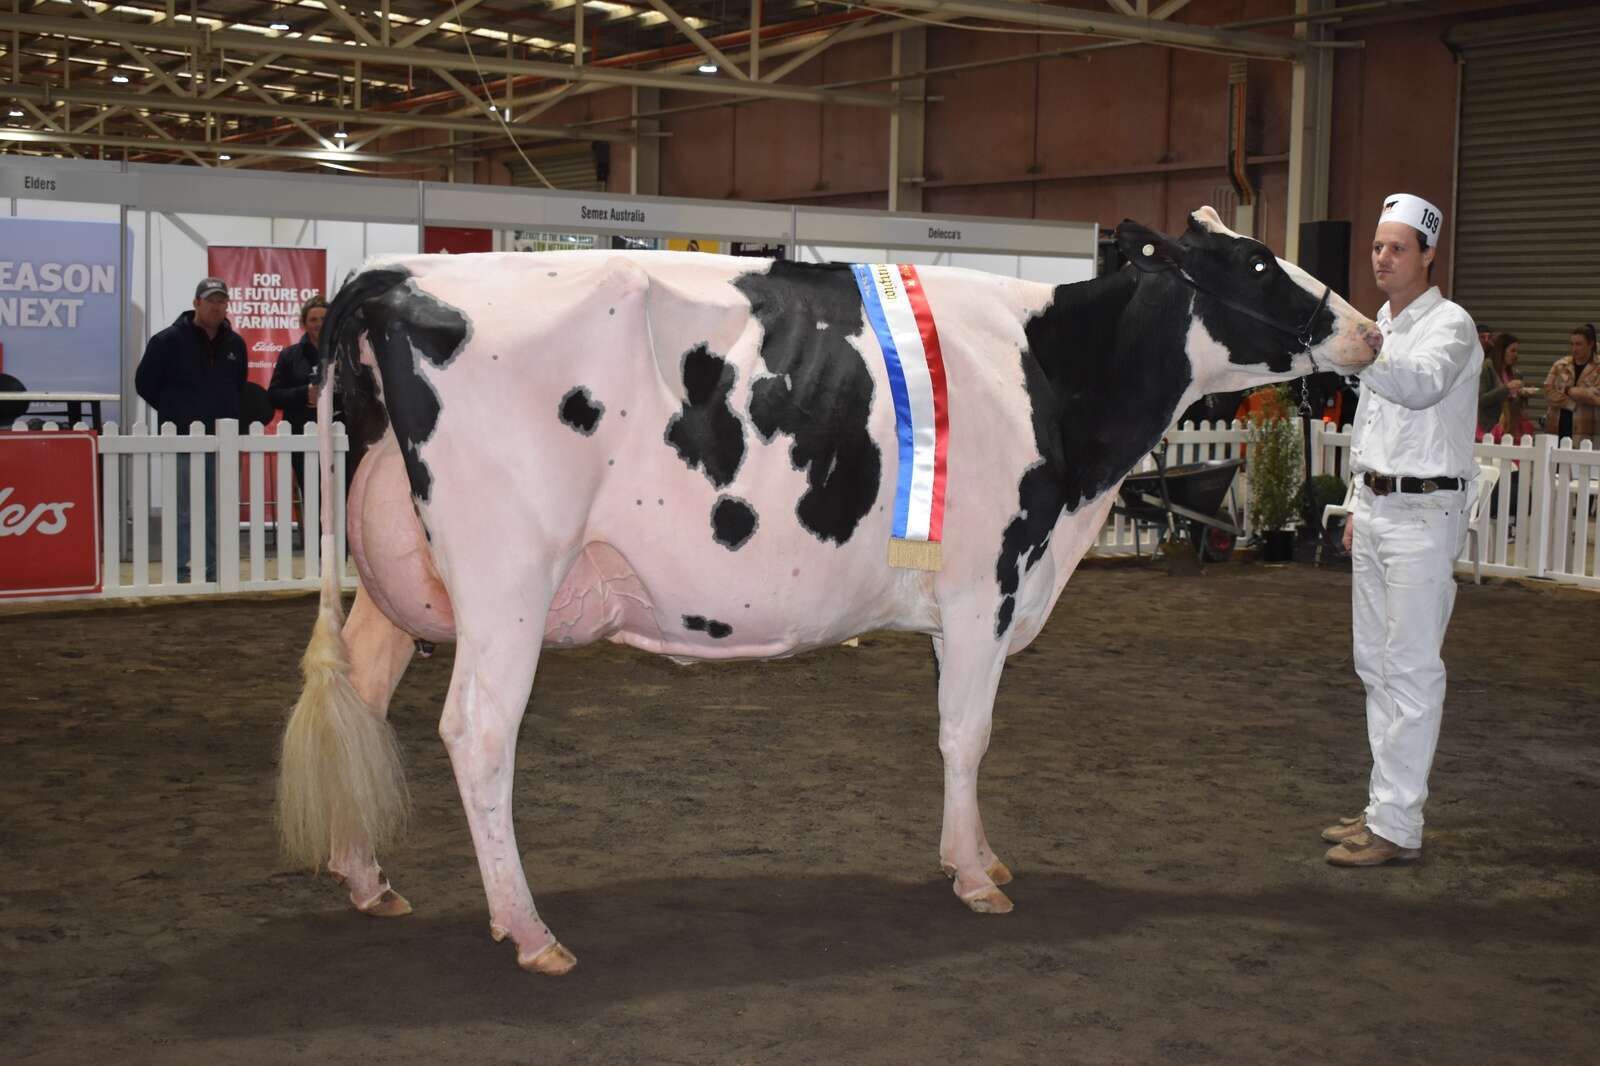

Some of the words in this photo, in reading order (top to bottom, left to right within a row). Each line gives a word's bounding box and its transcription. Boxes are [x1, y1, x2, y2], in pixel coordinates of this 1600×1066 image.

[24, 175, 57, 191] Elders
[581, 205, 608, 220] Semex
[610, 207, 645, 222] Australia
[1421, 208, 1440, 234] 199
[0, 261, 115, 293] EASON
[253, 273, 282, 287] FOR
[228, 287, 242, 301] HE
[244, 288, 298, 301] FUTURE
[0, 297, 84, 328] NEXT
[226, 301, 303, 315] AUSTRALIA
[235, 315, 301, 329] FARMING
[0, 487, 76, 536] ers
